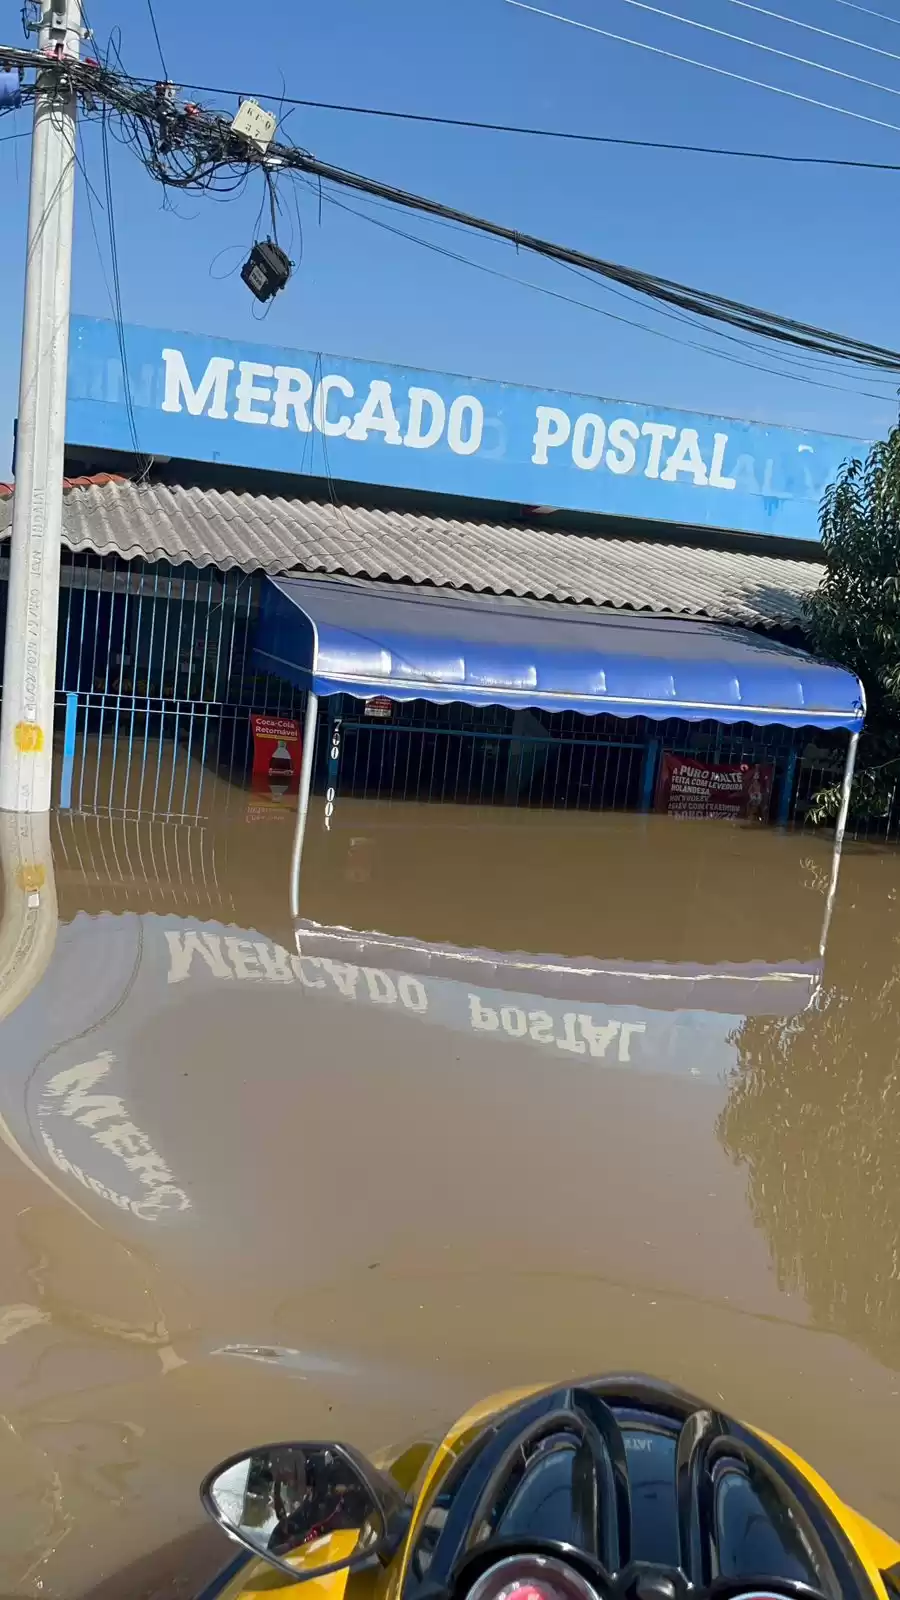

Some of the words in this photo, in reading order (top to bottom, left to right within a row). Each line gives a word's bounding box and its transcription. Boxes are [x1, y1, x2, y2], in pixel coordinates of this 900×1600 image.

[161, 348, 484, 456] MERCADO
[531, 405, 736, 491] POSTAL
[255, 718, 295, 730] Coca-Cola
[255, 725, 298, 737] Retornável
[680, 765, 709, 780] PURO
[711, 771, 743, 783] MALTE
[671, 775, 691, 785] FEITA
[691, 778, 708, 787] COM
